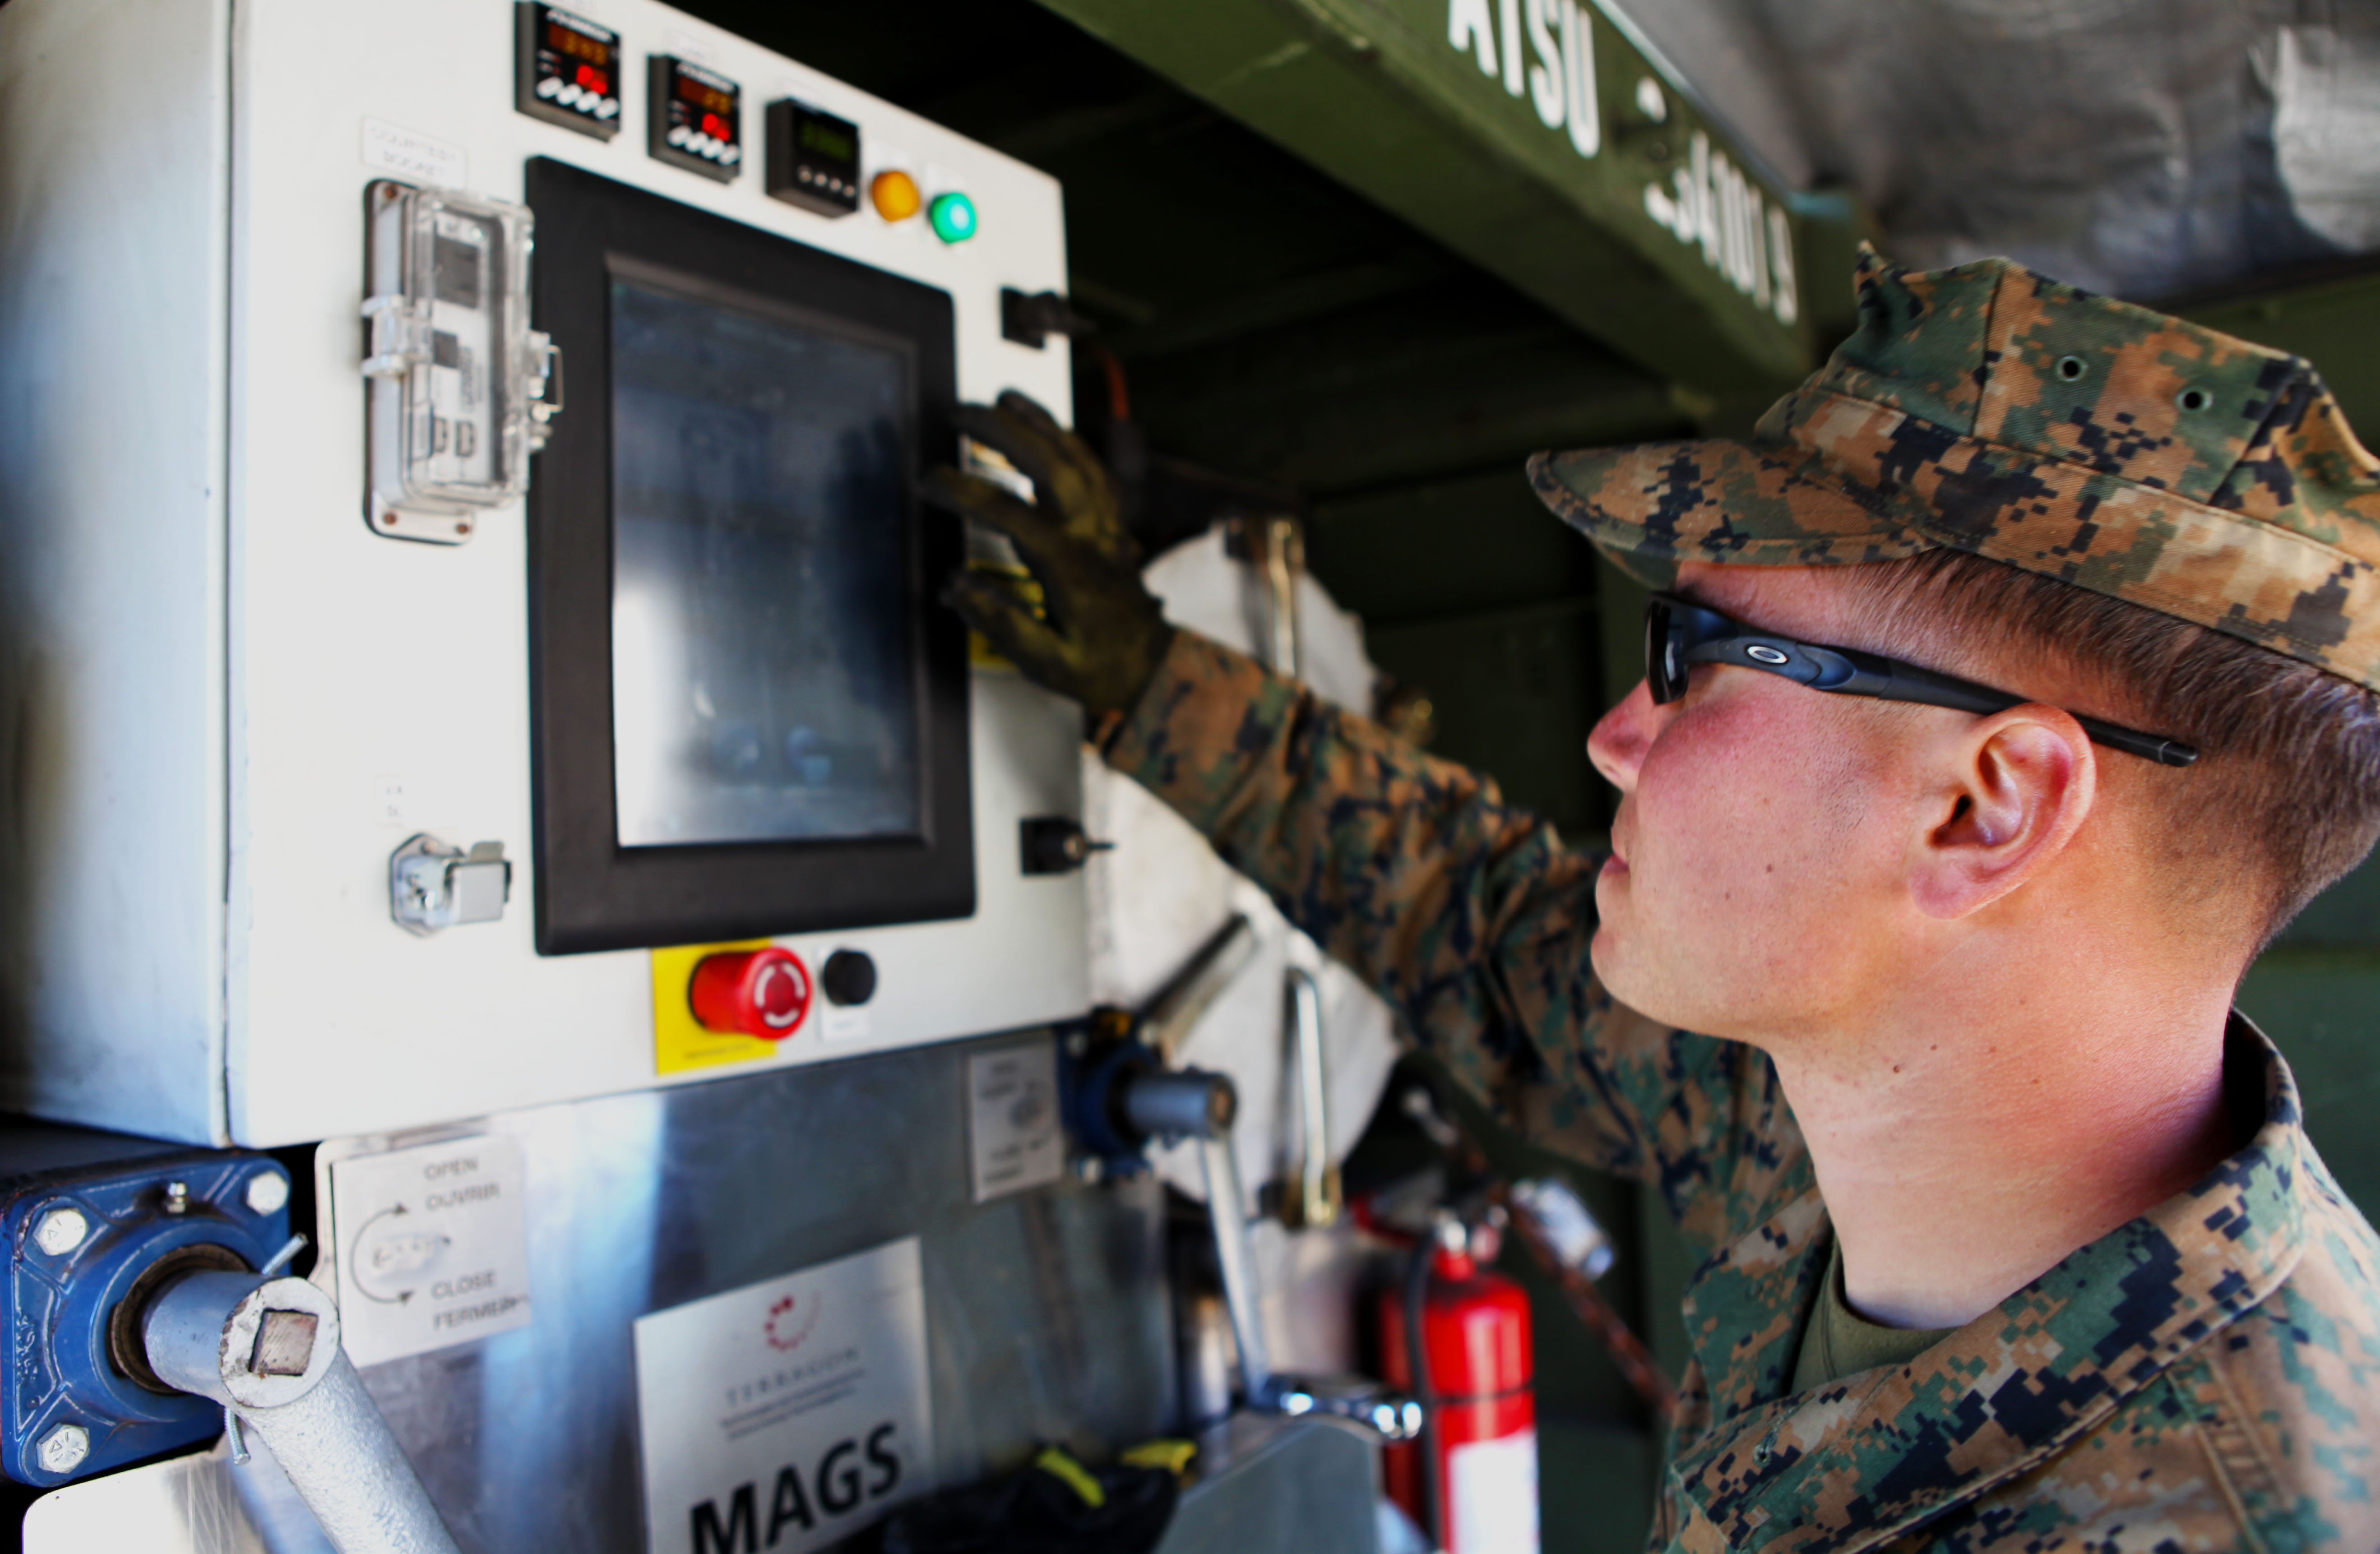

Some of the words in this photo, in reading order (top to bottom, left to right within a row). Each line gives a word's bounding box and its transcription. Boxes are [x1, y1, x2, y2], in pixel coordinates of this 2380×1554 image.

[423, 1156, 479, 1180] OPEN
[431, 1270, 496, 1300] CLOSE
[690, 1420, 900, 1554] MAGS
